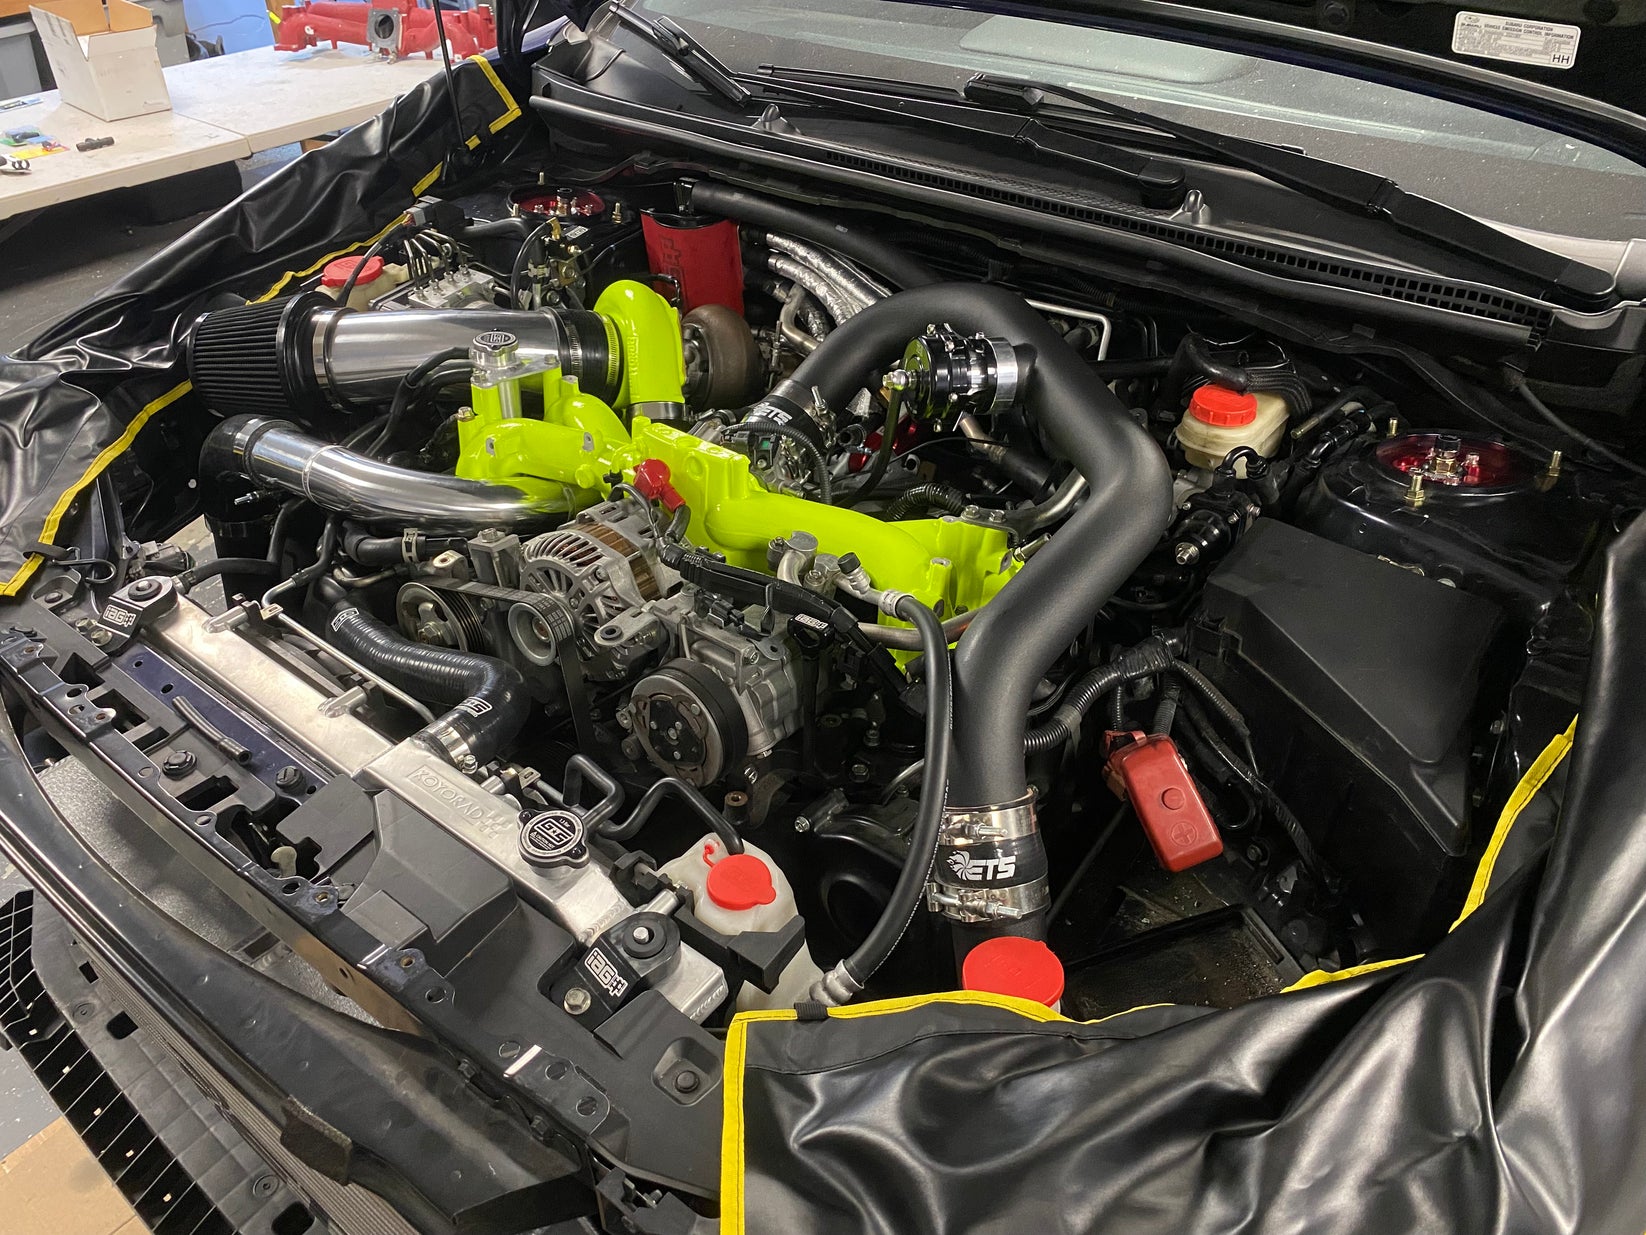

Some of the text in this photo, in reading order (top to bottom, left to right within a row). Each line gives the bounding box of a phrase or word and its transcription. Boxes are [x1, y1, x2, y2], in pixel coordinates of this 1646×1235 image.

[1552, 54, 1570, 64] HH
[755, 404, 793, 425] ETS
[416, 769, 485, 820] KOYORAD
[966, 855, 1017, 881] ETS
